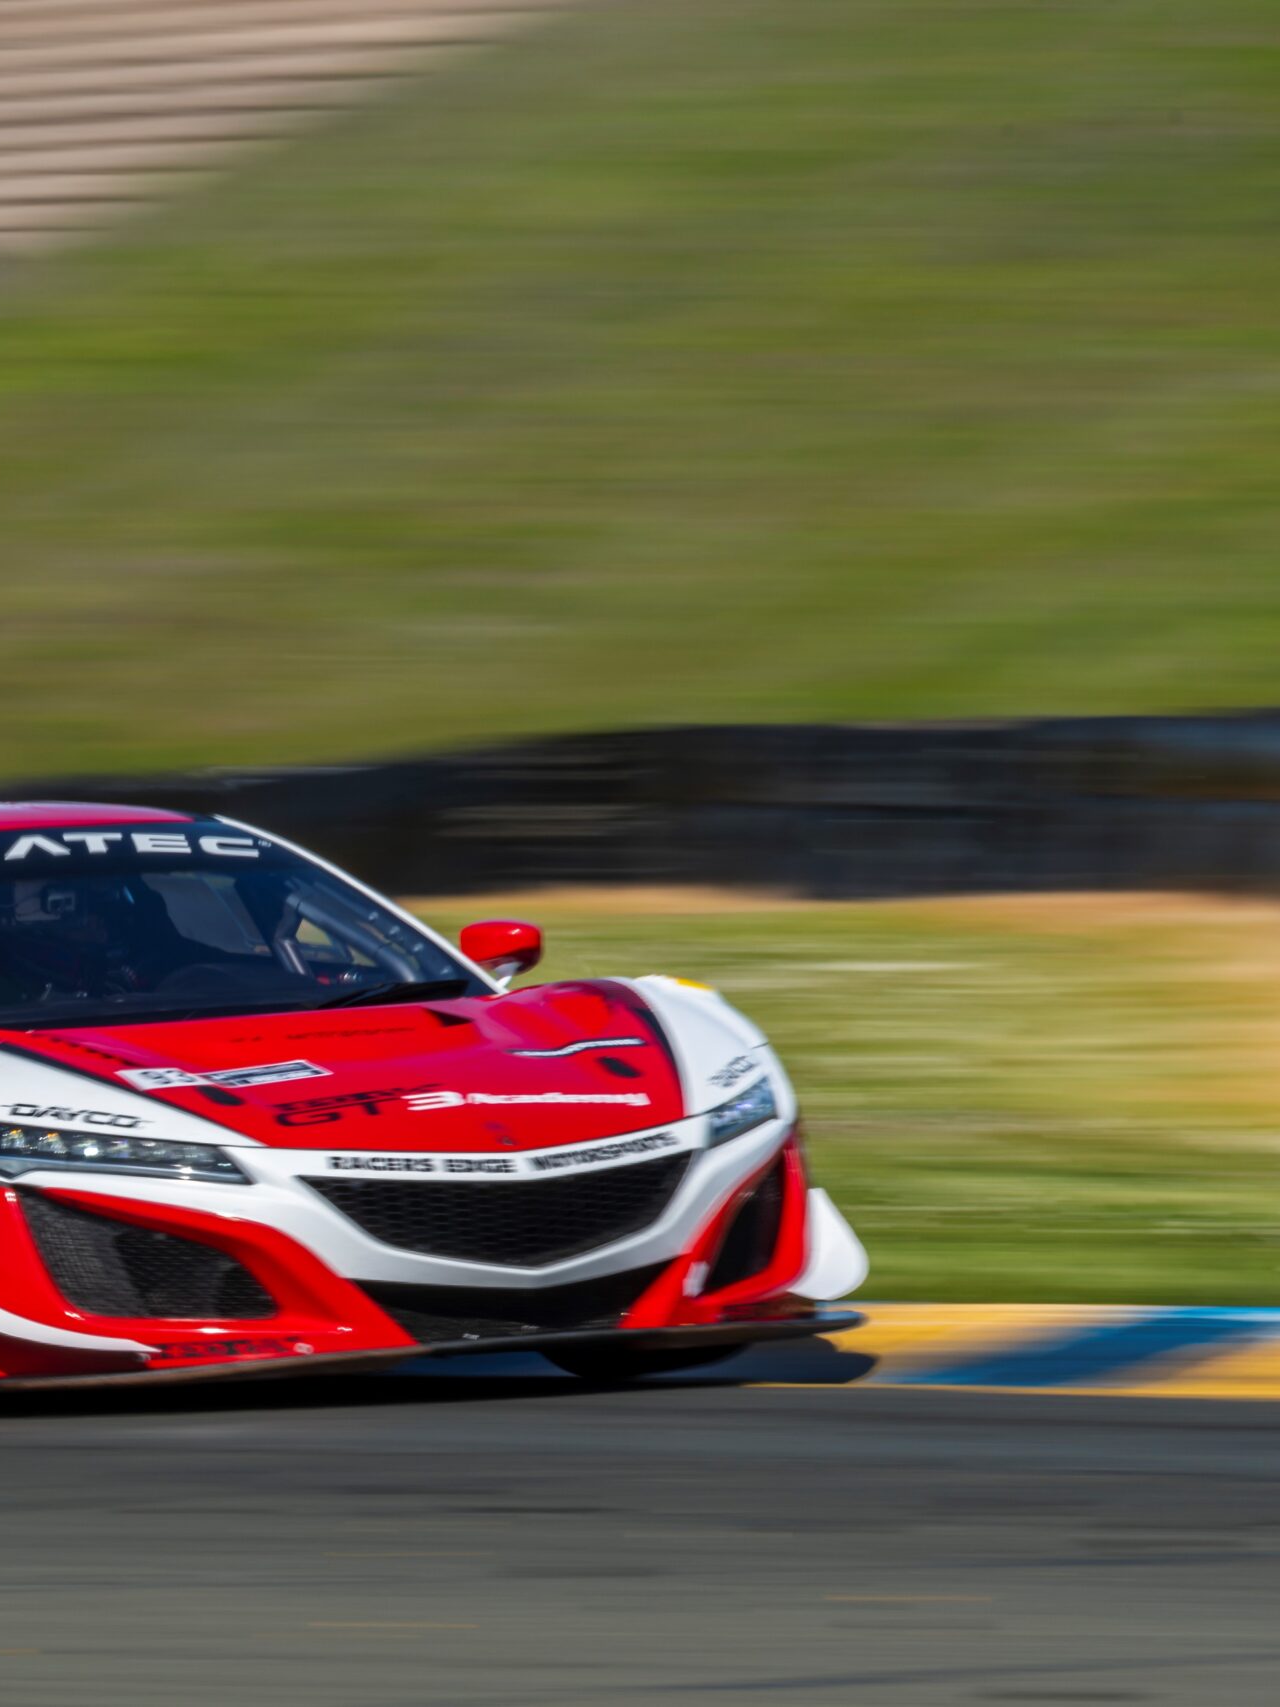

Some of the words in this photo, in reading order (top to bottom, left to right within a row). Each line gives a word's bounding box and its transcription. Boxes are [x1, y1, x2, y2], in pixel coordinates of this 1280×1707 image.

[8, 1103, 144, 1129] DAYCO
[276, 1090, 466, 1127] GT3
[326, 1155, 434, 1173] RACERS
[443, 1158, 519, 1174] EDGE
